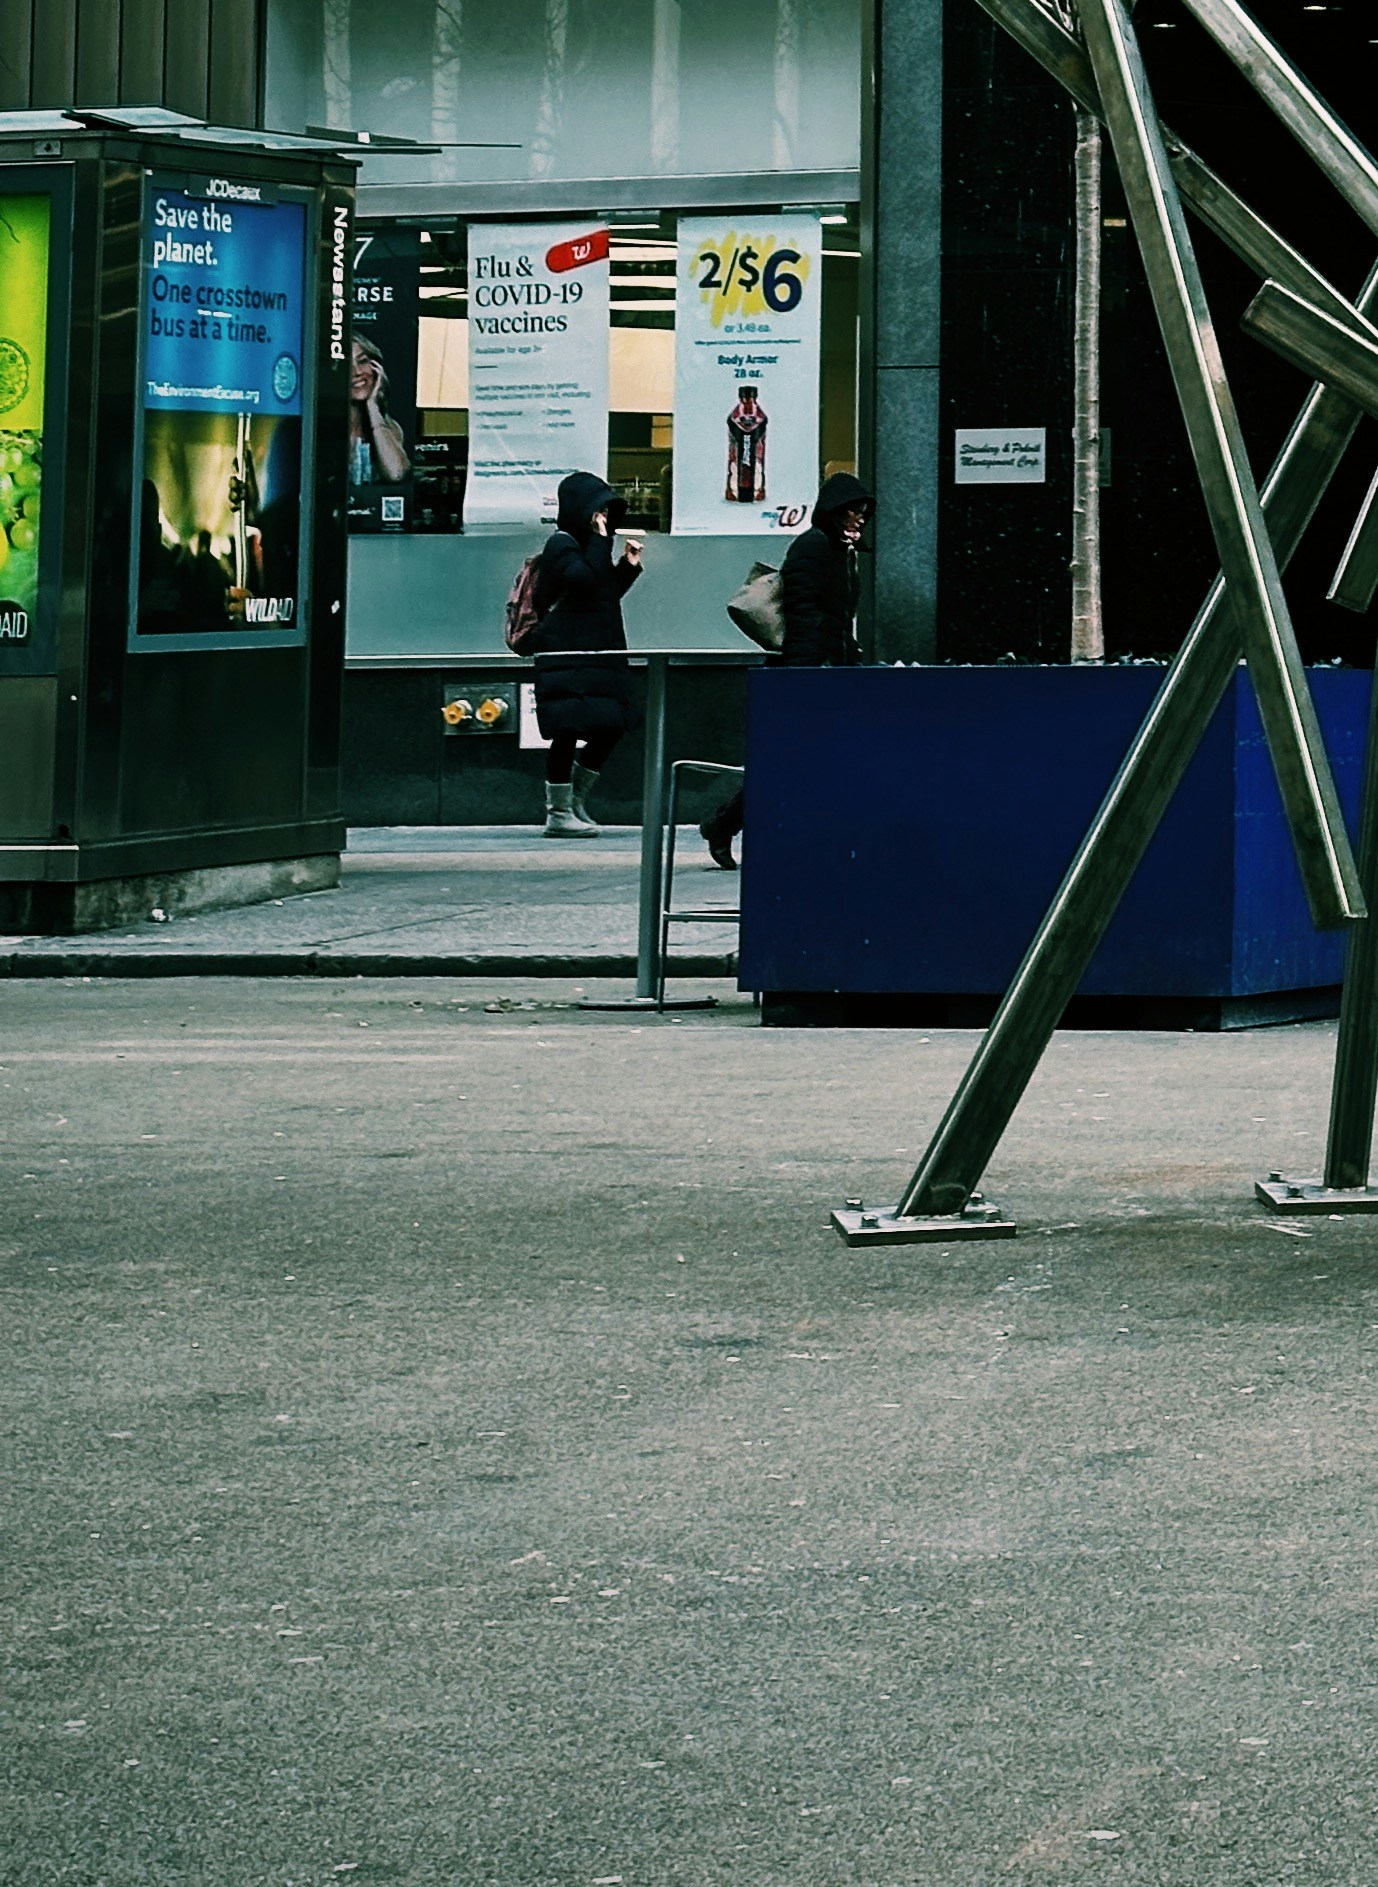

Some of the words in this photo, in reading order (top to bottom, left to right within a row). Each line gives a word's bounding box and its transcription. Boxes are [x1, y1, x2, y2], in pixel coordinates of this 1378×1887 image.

[205, 179, 261, 200] JCDecaux
[155, 198, 199, 229] Save
[202, 202, 233, 233] the
[153, 231, 218, 269] planet.
[475, 255, 512, 279] Flu
[515, 254, 534, 278] &
[698, 245, 803, 313] 2/$6
[152, 273, 191, 304] One
[196, 284, 288, 311] crosstown
[330, 206, 349, 360] Newsstand
[475, 281, 584, 308] COVID-19
[151, 307, 185, 338] bus
[189, 314, 208, 340] at
[211, 323, 223, 341] a
[227, 315, 272, 343] time.
[474, 310, 569, 335] vaccines
[717, 354, 745, 368] Body
[745, 354, 779, 365] Armor
[1001, 442, 1011, 453] &
